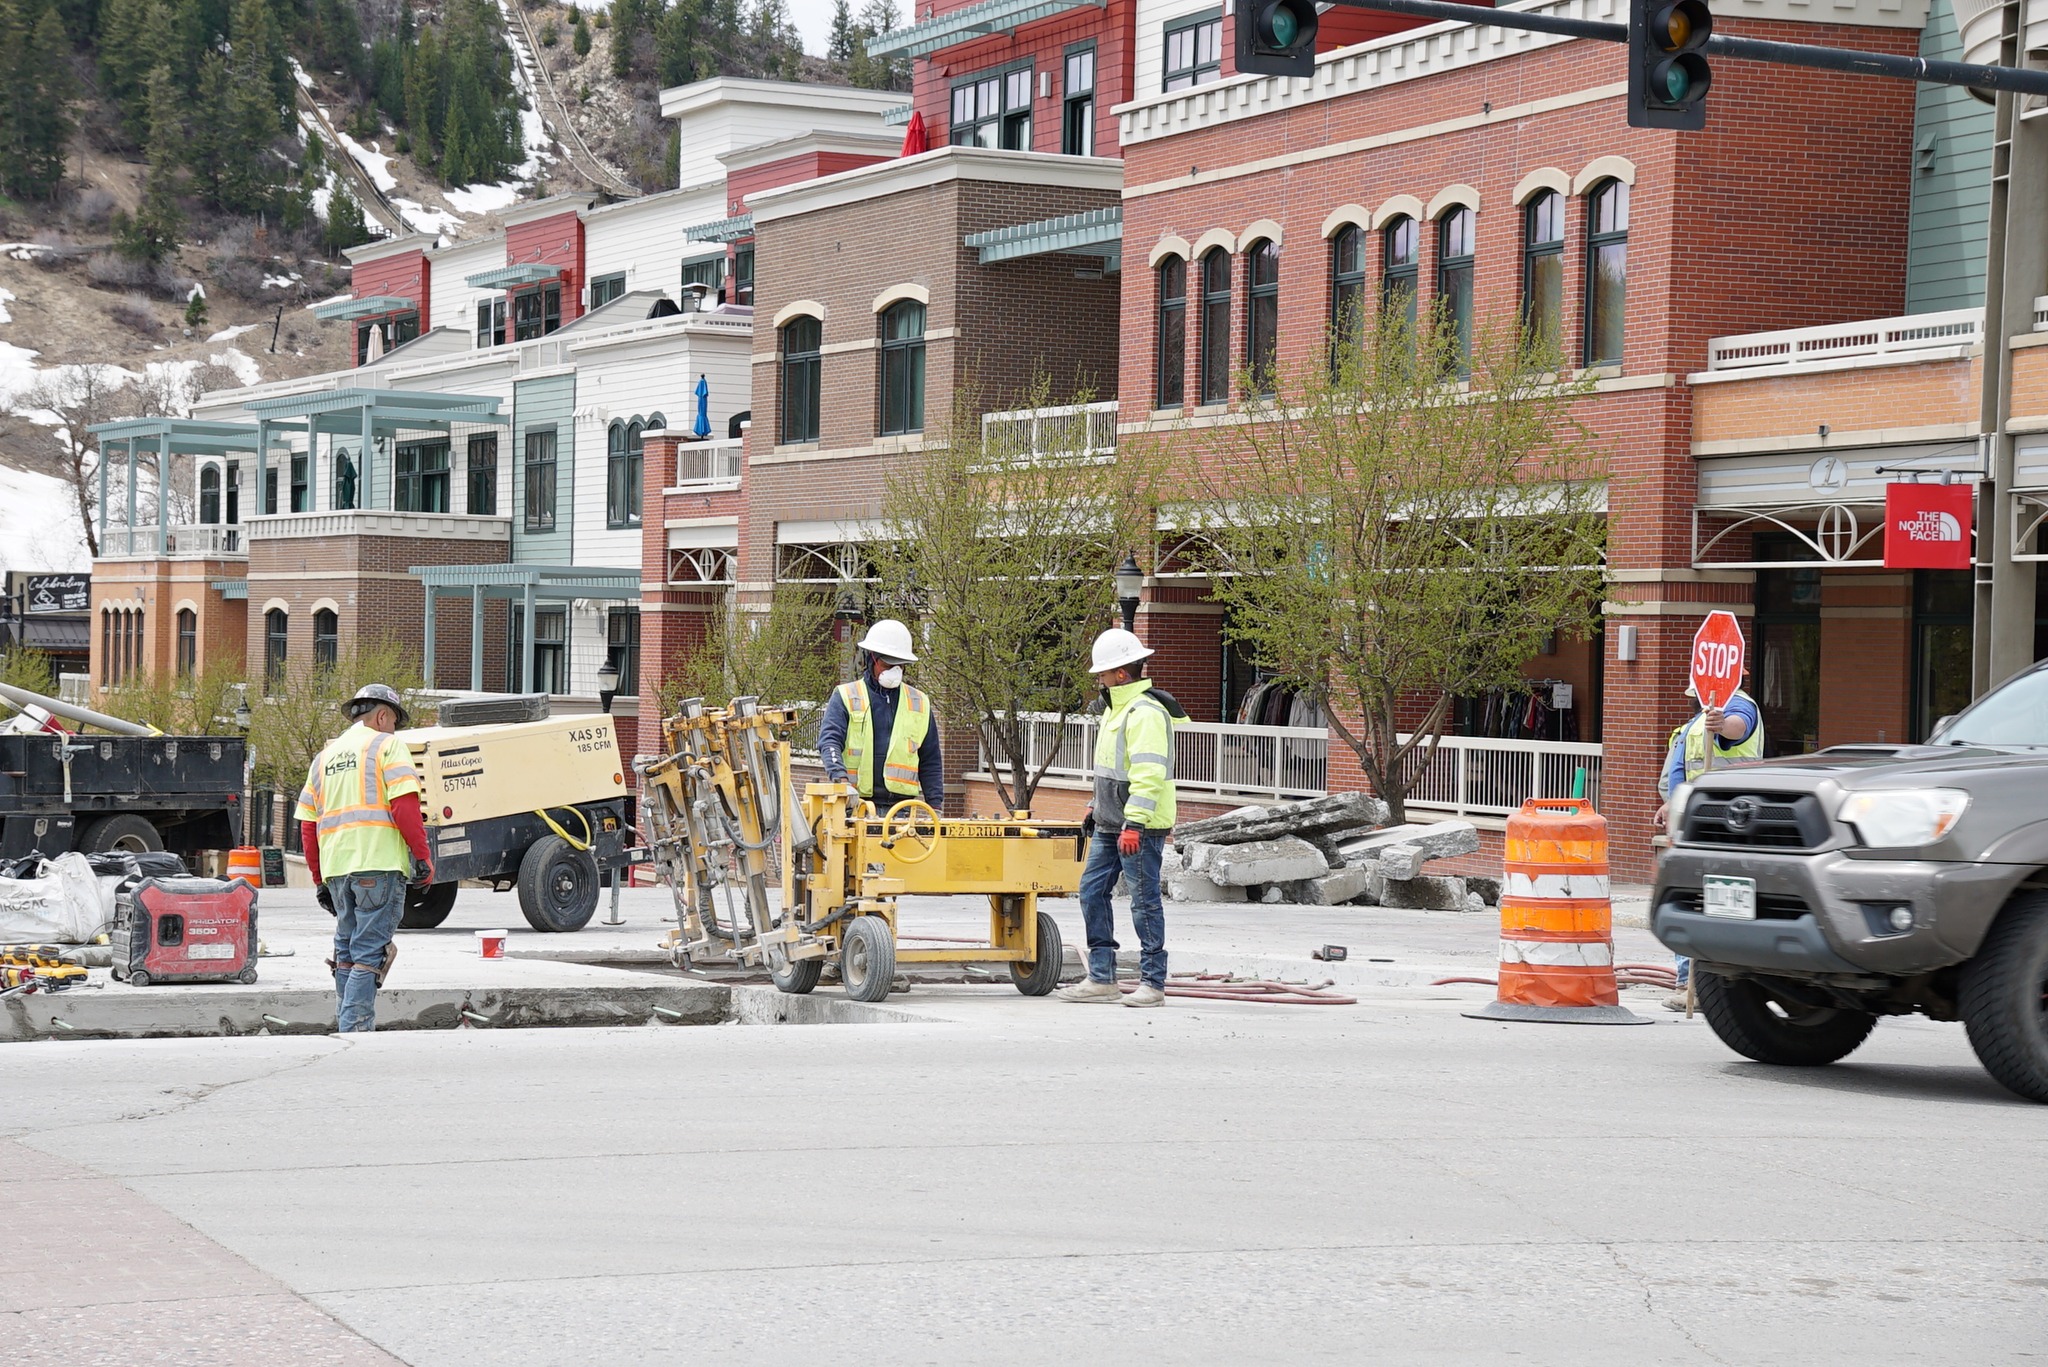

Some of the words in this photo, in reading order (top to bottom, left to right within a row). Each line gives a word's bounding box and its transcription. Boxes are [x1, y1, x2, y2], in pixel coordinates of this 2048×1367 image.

[1917, 511, 1940, 521] THE
[1899, 520, 1940, 531] NORTH
[1910, 530, 1940, 541] FACE
[28, 575, 87, 593] Celebrating
[1695, 641, 1740, 679] STOP
[568, 728, 593, 742] XAS
[595, 726, 608, 739] 97
[577, 742, 592, 752] 185
[593, 740, 612, 751] CFM
[440, 758, 461, 769] Atlas
[461, 756, 483, 767] Copco
[443, 775, 478, 793] 657944
[967, 826, 1003, 837] DRILL
[188, 927, 218, 935] 3500
